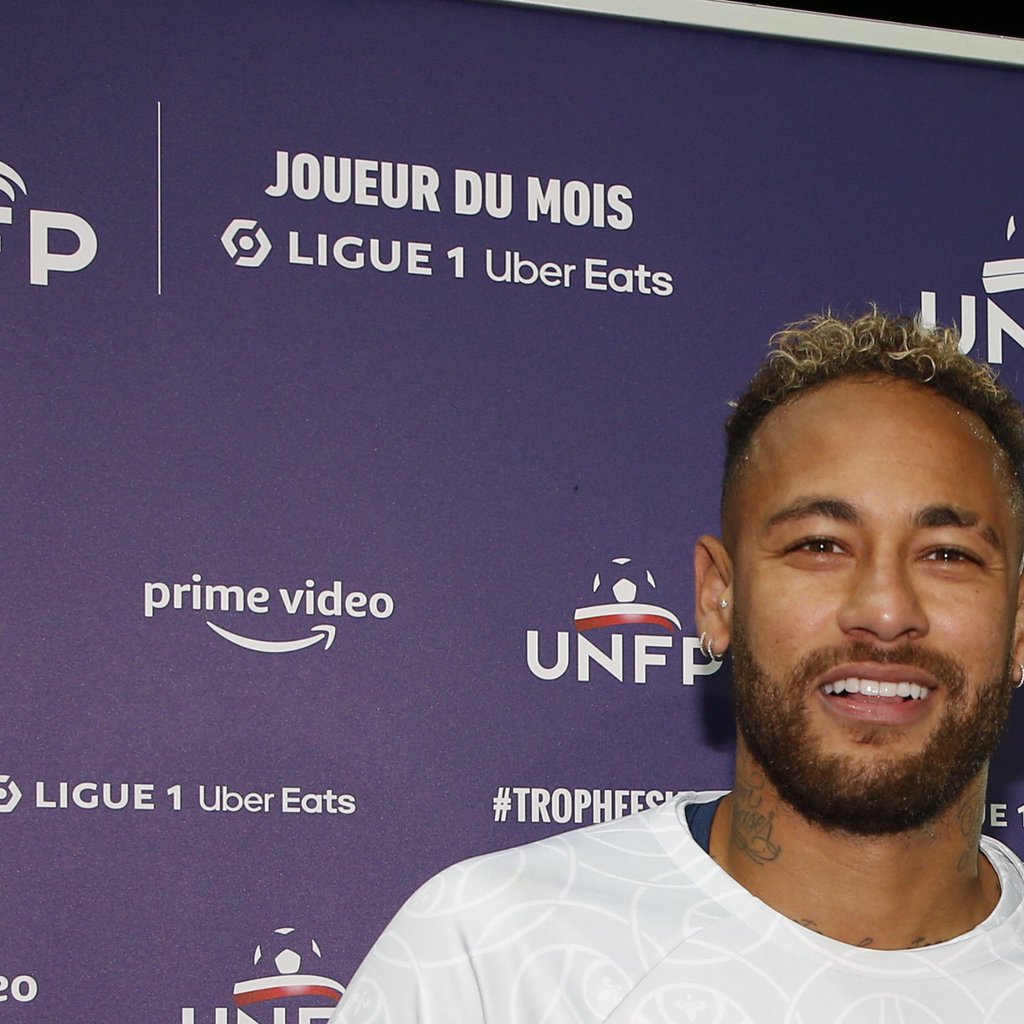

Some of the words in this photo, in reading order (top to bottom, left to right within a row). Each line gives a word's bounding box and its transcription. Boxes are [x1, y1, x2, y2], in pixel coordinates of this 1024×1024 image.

[265, 150, 440, 213] JOUEUR
[455, 169, 513, 219] DU
[527, 176, 634, 231] MOIS
[289, 231, 432, 276] LIGUE
[446, 246, 466, 279] 1
[486, 249, 576, 288] Uber
[585, 258, 674, 297] Eats
[144, 574, 269, 618] prime
[279, 579, 395, 619] video
[526, 630, 723, 686] UNFP
[35, 781, 155, 811] LIGUE
[166, 784, 182, 811] 1
[199, 785, 274, 813] Uber
[281, 787, 357, 815] Eats
[493, 786, 673, 824] #TROPHEES
